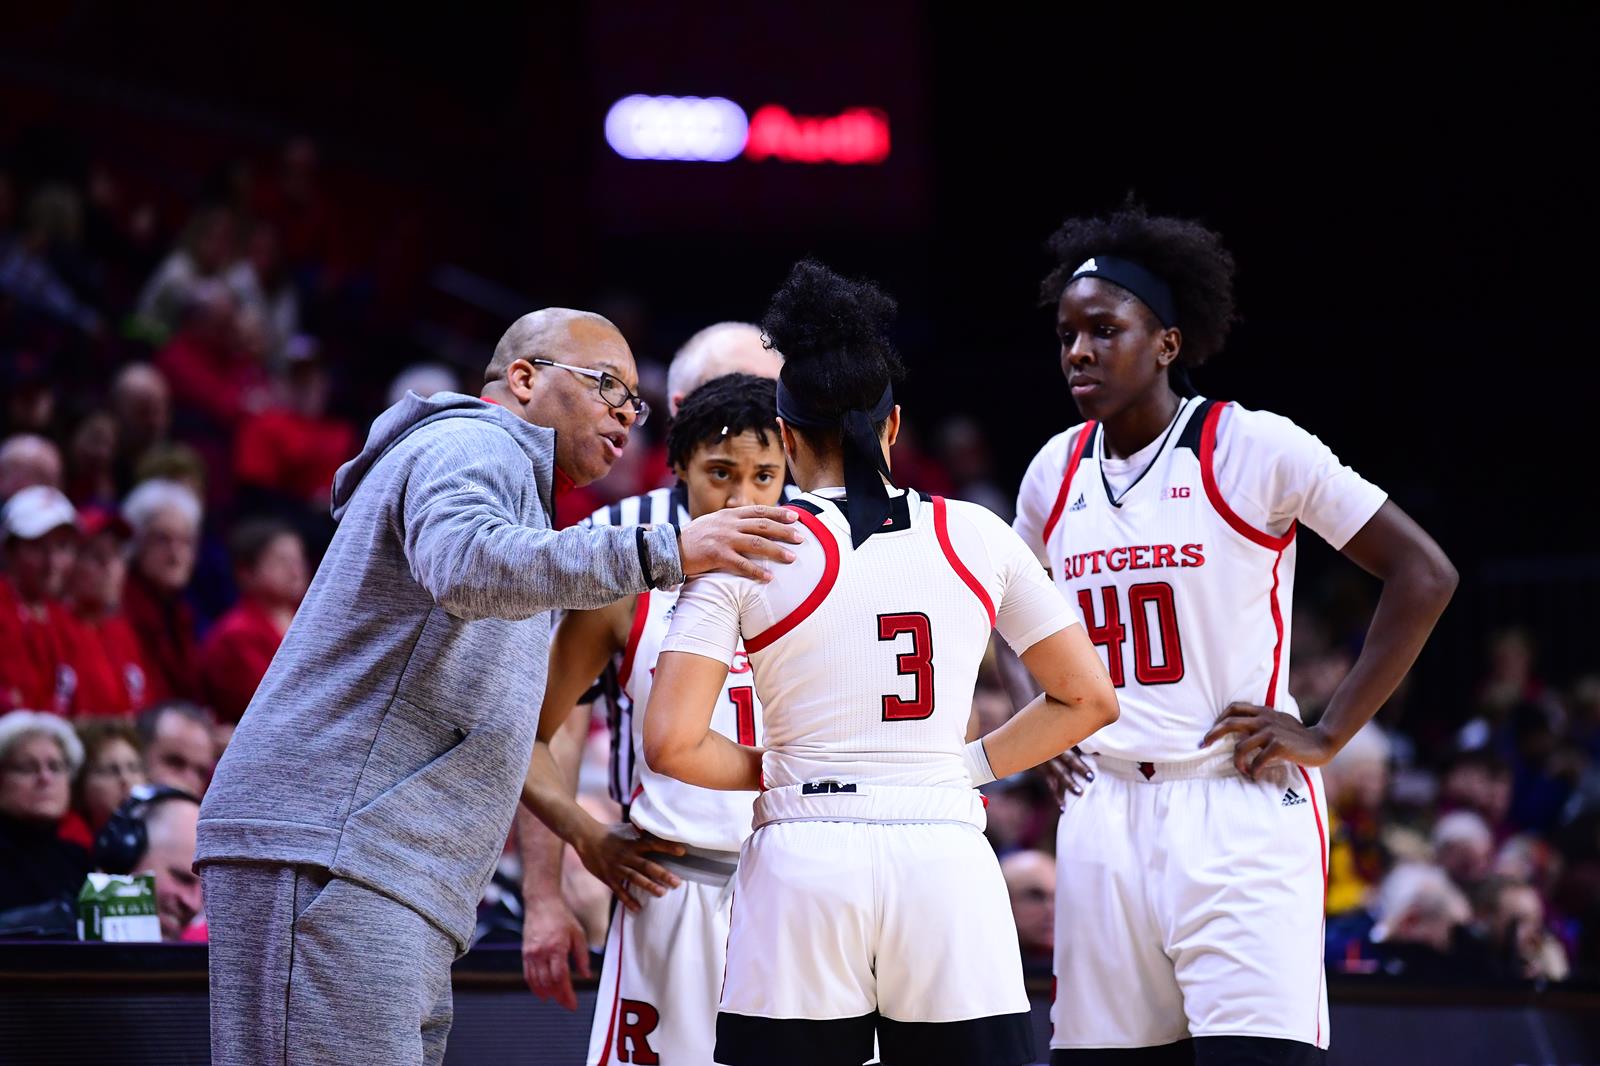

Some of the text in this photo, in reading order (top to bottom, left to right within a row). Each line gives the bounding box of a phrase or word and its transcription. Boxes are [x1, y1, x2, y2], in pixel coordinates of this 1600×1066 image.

[1065, 544, 1205, 580] RUTGERS
[877, 611, 935, 722] 3
[1077, 582, 1184, 688] 40
[728, 686, 756, 747] 1
[617, 998, 660, 1065] R
